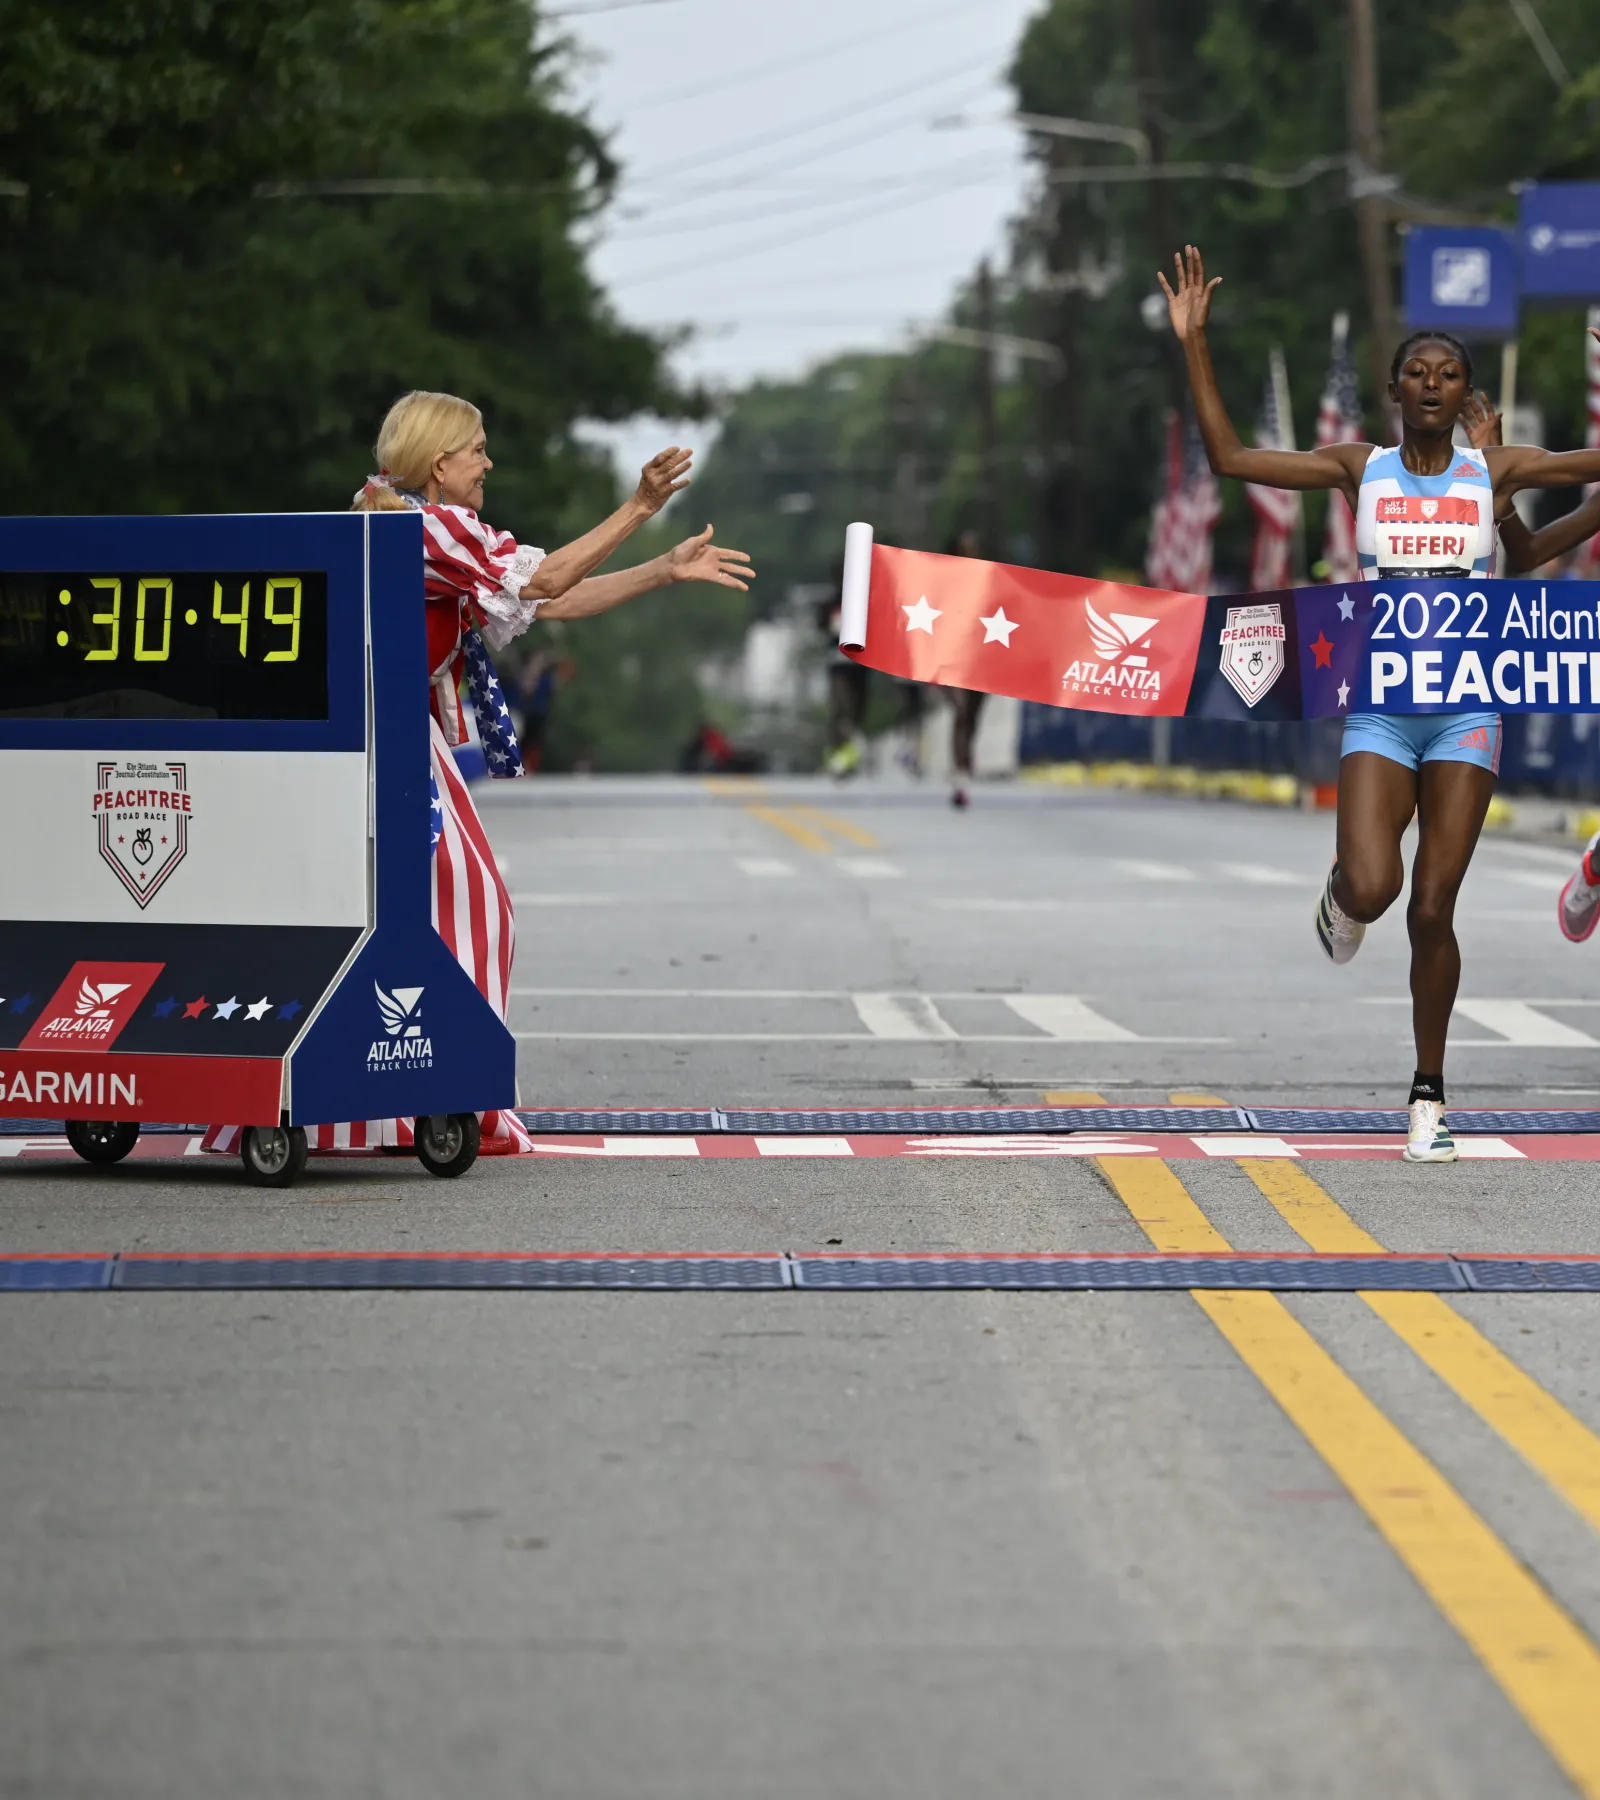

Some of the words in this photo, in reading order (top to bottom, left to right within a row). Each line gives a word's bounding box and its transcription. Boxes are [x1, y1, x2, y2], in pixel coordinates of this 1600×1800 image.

[1388, 535, 1465, 555] TEFERI
[1371, 591, 1489, 640] 2022
[1222, 625, 1284, 642] PEACHTREE
[1062, 659, 1161, 691] ATLANTA
[1062, 680, 1112, 696] TRACK
[1120, 689, 1160, 701] CLUB
[114, 770, 170, 779] Journal-Constitution
[126, 763, 137, 771] The
[138, 762, 158, 771] Atlanta
[93, 790, 192, 812] PEACHTREE
[117, 812, 140, 821] ROAD
[144, 812, 167, 821] RACE
[43, 1017, 115, 1033] ATLANTA
[39, 1031, 73, 1039] TRACK
[79, 1032, 107, 1040] CLUB
[366, 1037, 433, 1062] ATLANTA
[367, 1061, 401, 1072] TRACK
[406, 1058, 433, 1069] CLUB
[0, 1070, 137, 1106] ARMIN
